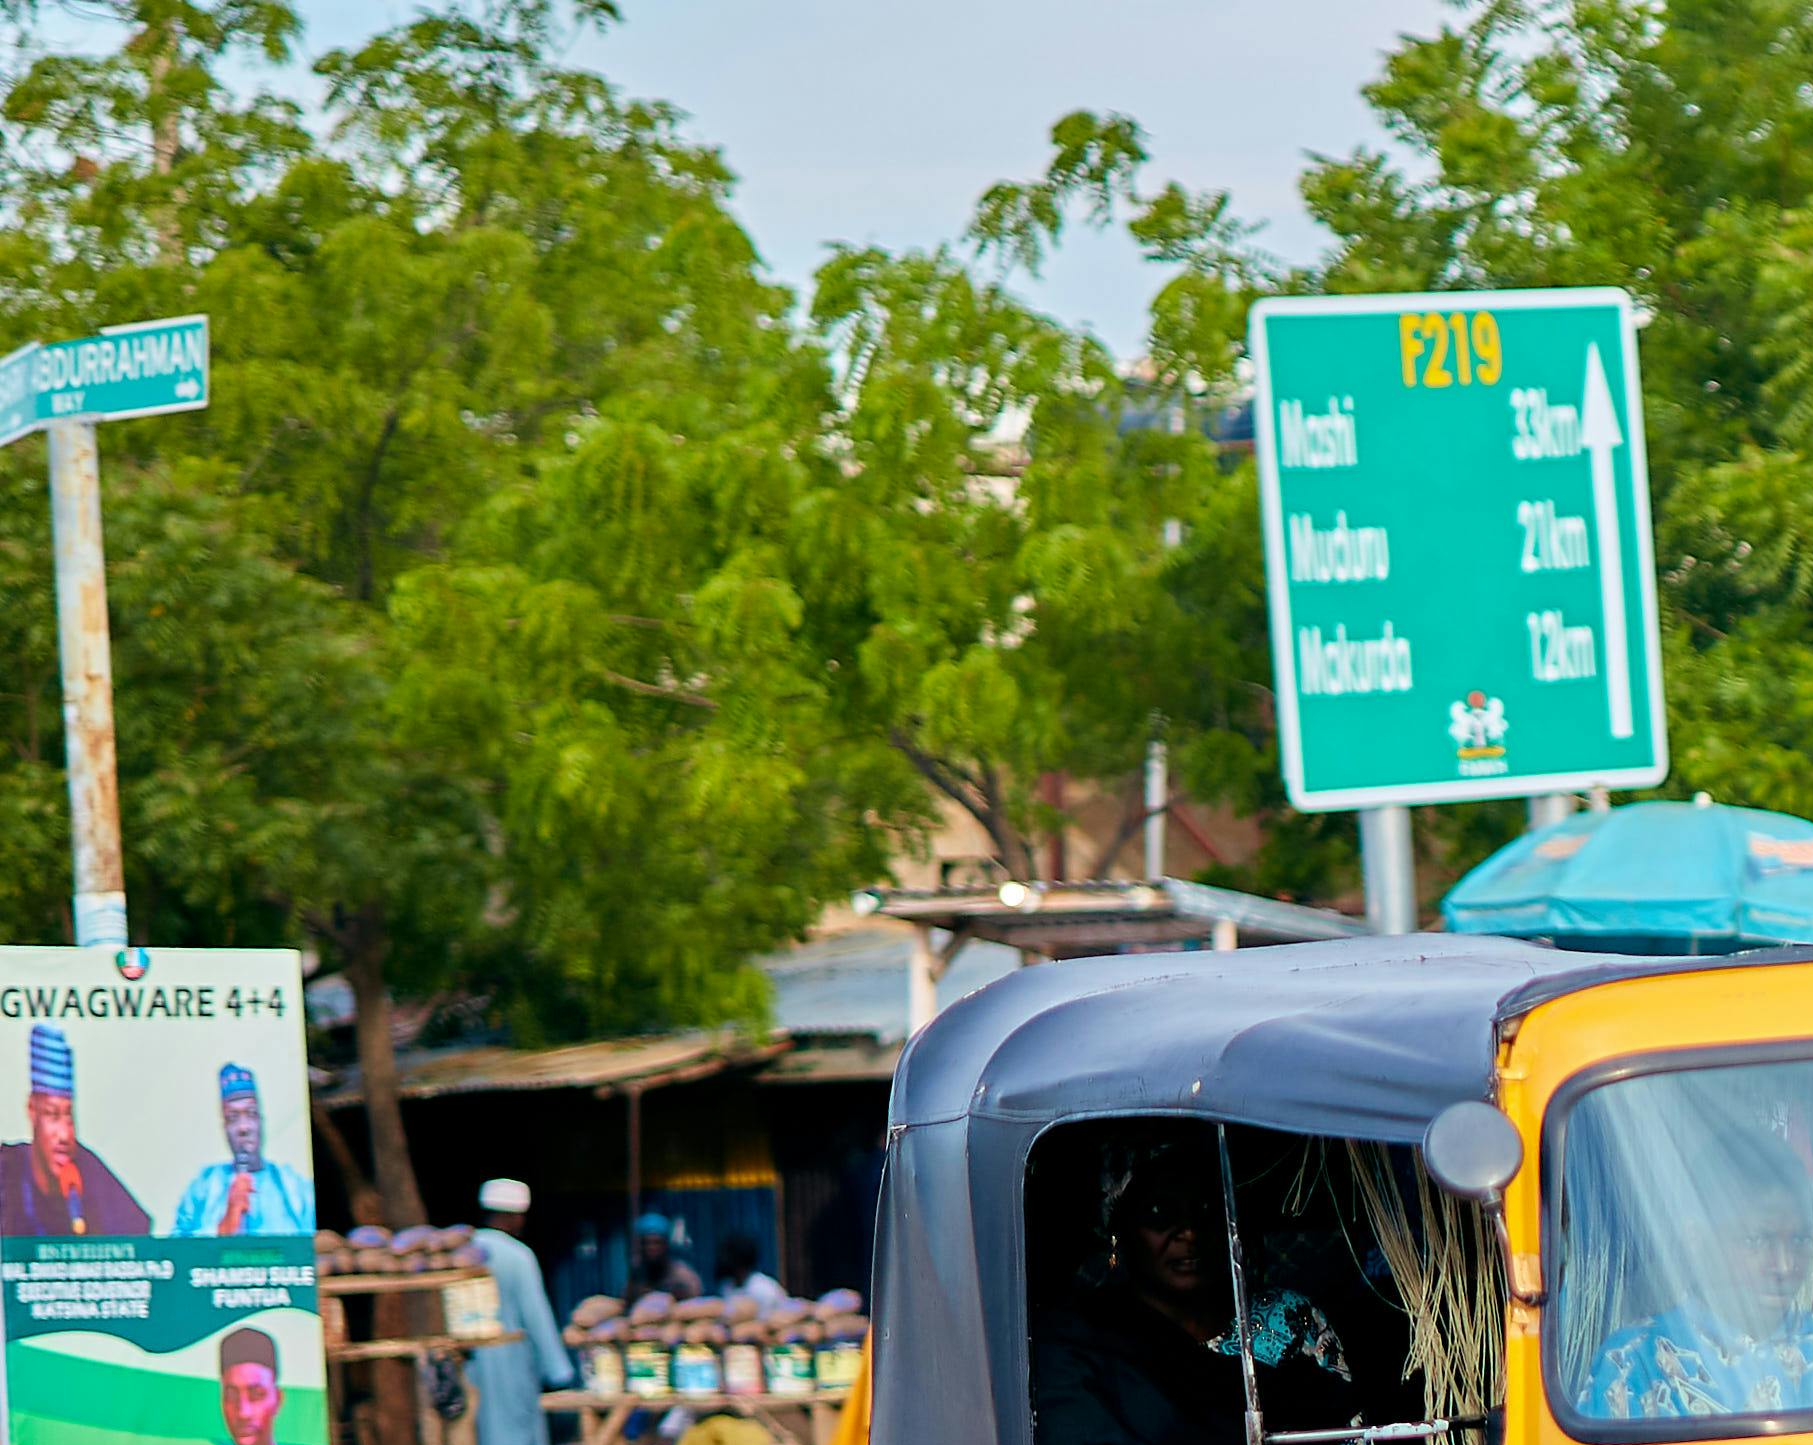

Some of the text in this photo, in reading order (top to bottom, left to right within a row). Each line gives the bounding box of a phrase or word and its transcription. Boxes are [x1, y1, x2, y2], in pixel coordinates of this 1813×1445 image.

[1399, 311, 1502, 388] F219
[1510, 388, 1581, 459] 33km
[1517, 499, 1591, 573] 21km
[1527, 610, 1597, 682] 12km
[1, 986, 286, 1018] GWAGWARE 4+4
